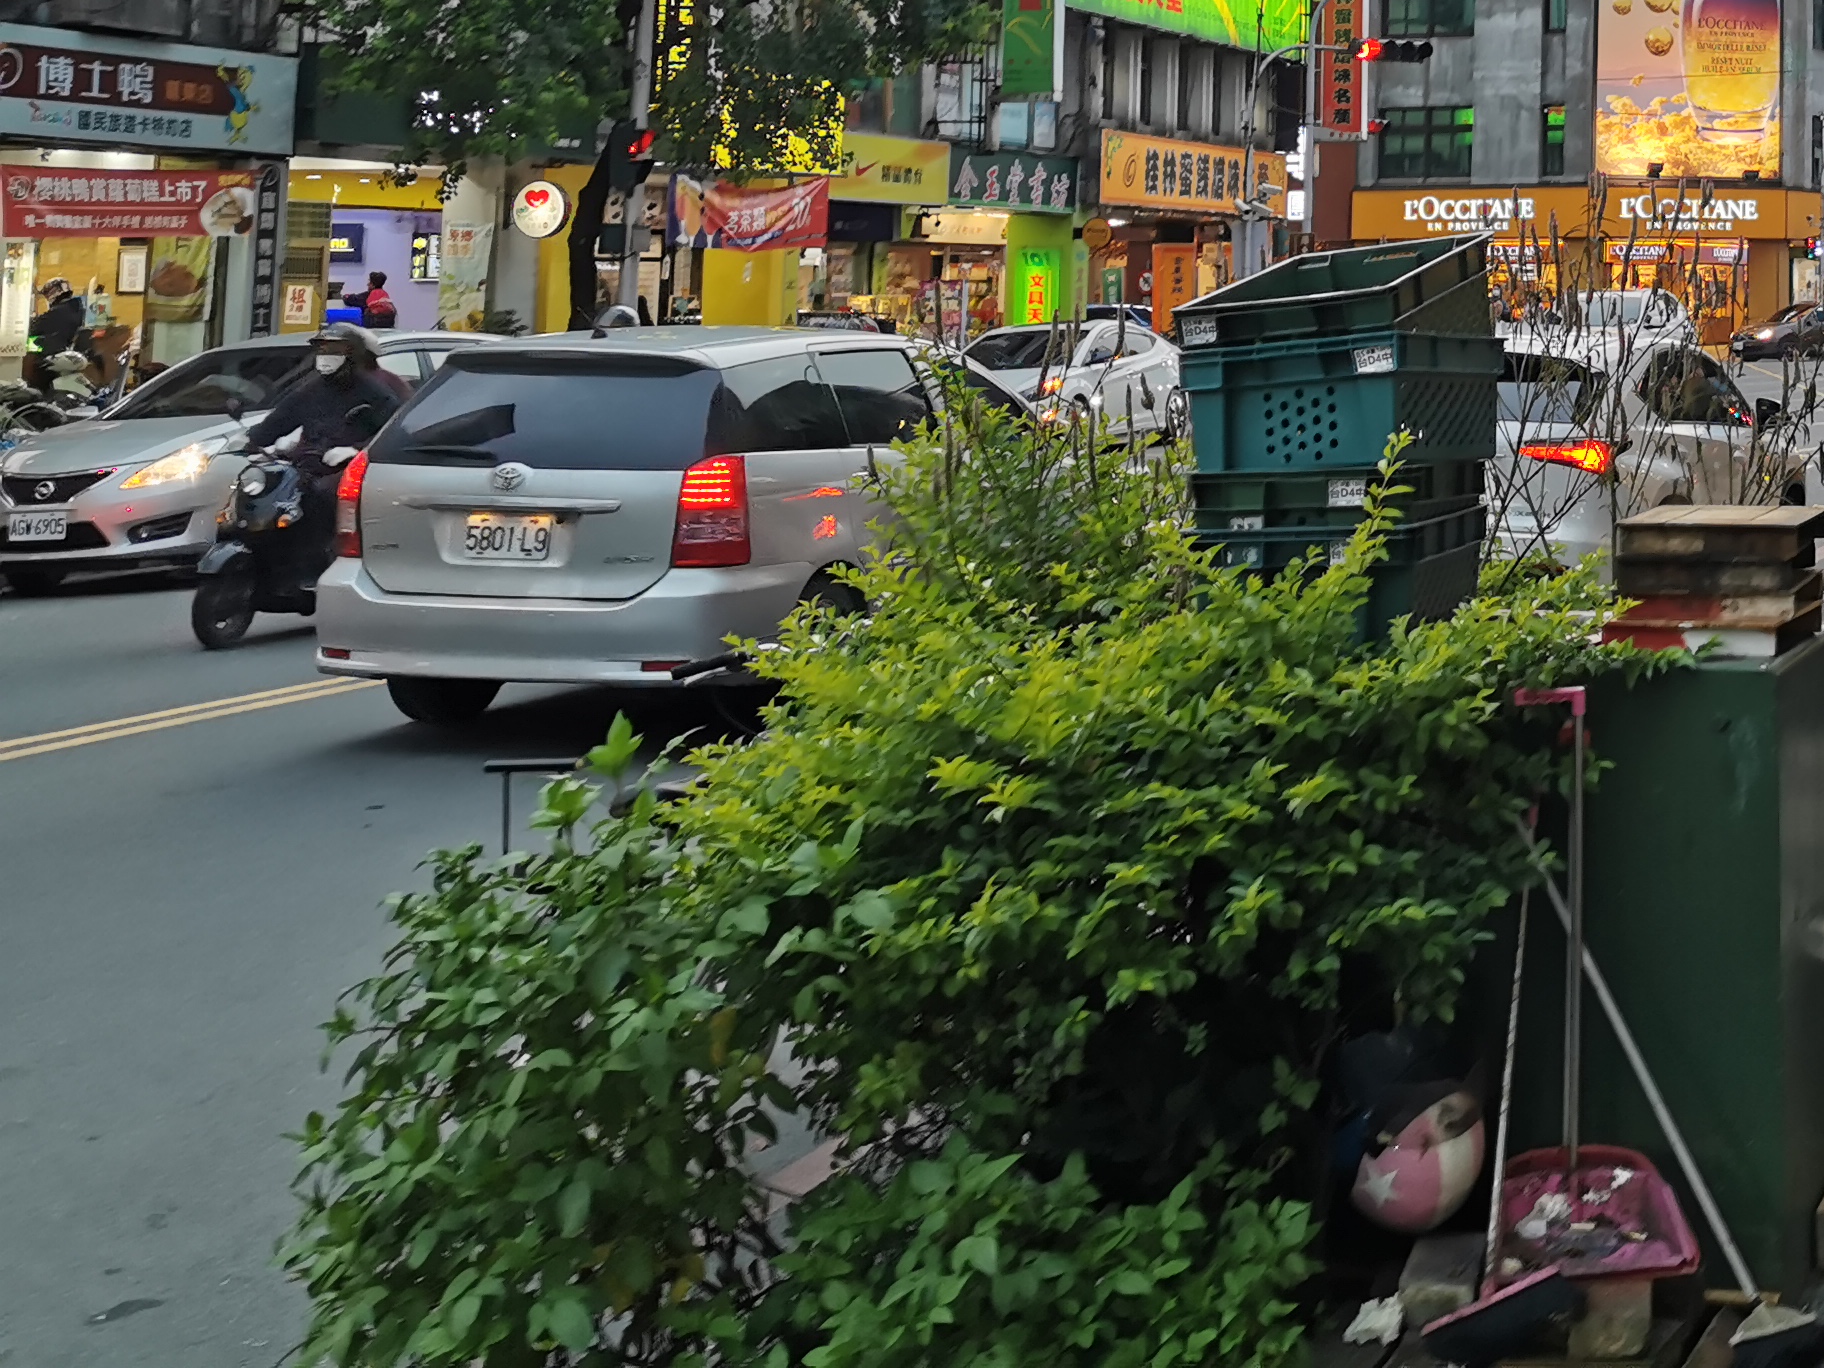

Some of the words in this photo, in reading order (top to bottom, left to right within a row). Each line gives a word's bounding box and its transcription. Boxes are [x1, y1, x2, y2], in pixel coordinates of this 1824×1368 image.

[36, 54, 156, 105] 博士鴨
[1404, 195, 1534, 221] L'OCCITANE
[1620, 196, 1759, 221] L'OCCITANE
[1427, 222, 1443, 231] EN
[1448, 222, 1509, 231] PROVENCE
[465, 525, 549, 553] 5801-L9
